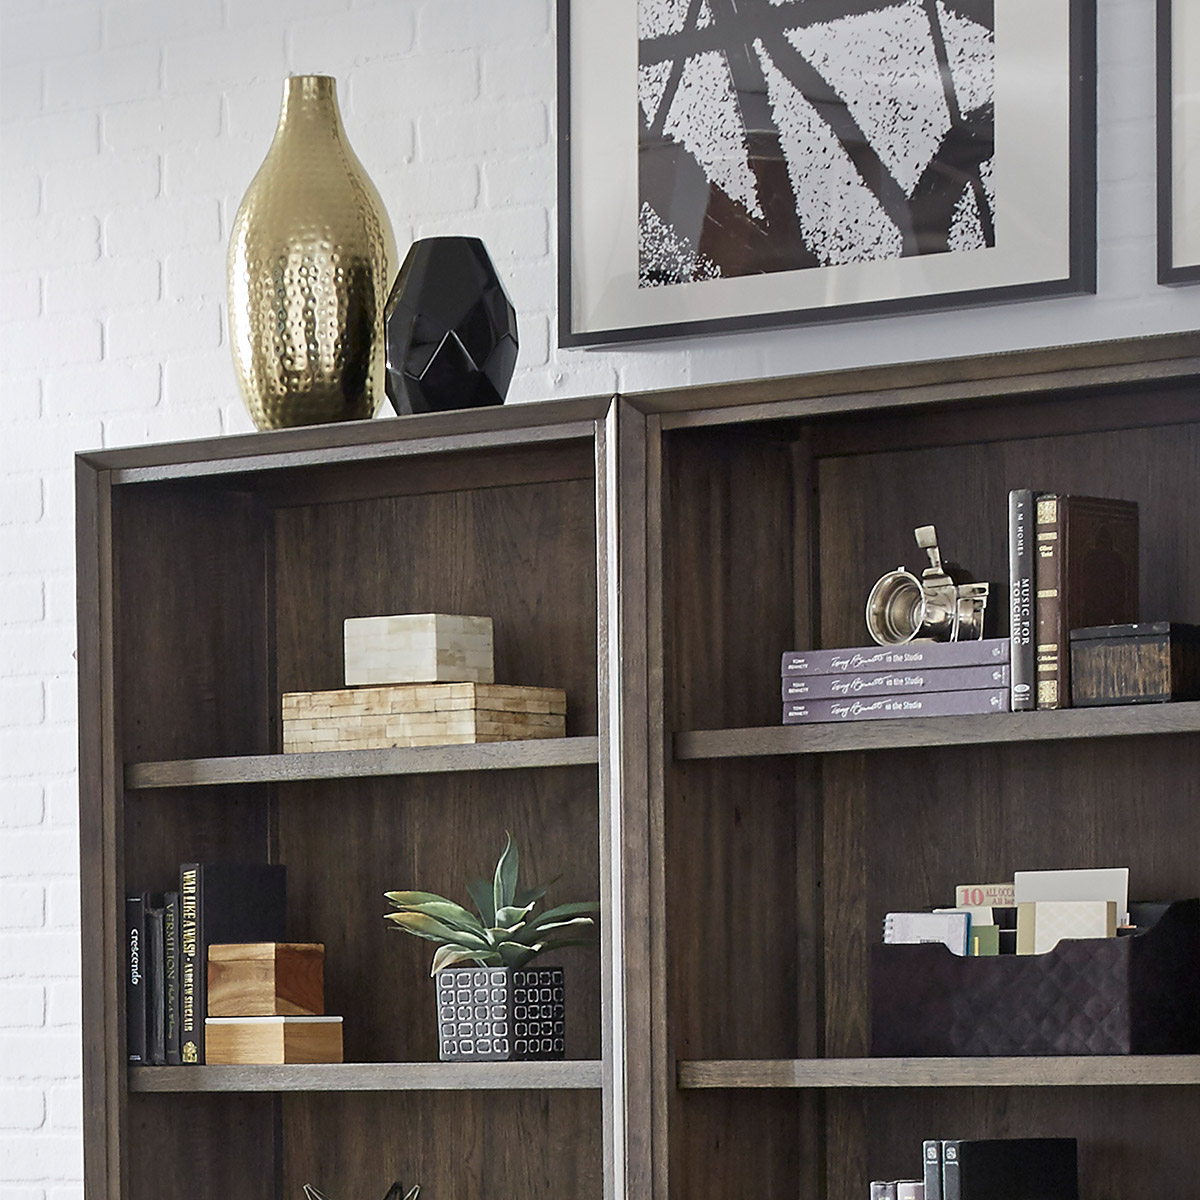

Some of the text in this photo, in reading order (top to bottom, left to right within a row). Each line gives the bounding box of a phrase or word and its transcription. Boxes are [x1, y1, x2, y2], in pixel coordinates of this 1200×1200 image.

[1013, 580, 1021, 644] TORCHING
[1021, 578, 1030, 645] MUSIC FOR
[182, 870, 197, 894] WAR
[960, 888, 984, 906] 10
[182, 895, 196, 919] LIKE
[130, 928, 142, 985] crescendo
[165, 903, 175, 980] VERMILION
[182, 928, 196, 957] WASP
[184, 963, 193, 996] ANDREW
[184, 996, 193, 1032] SINCLAIR
